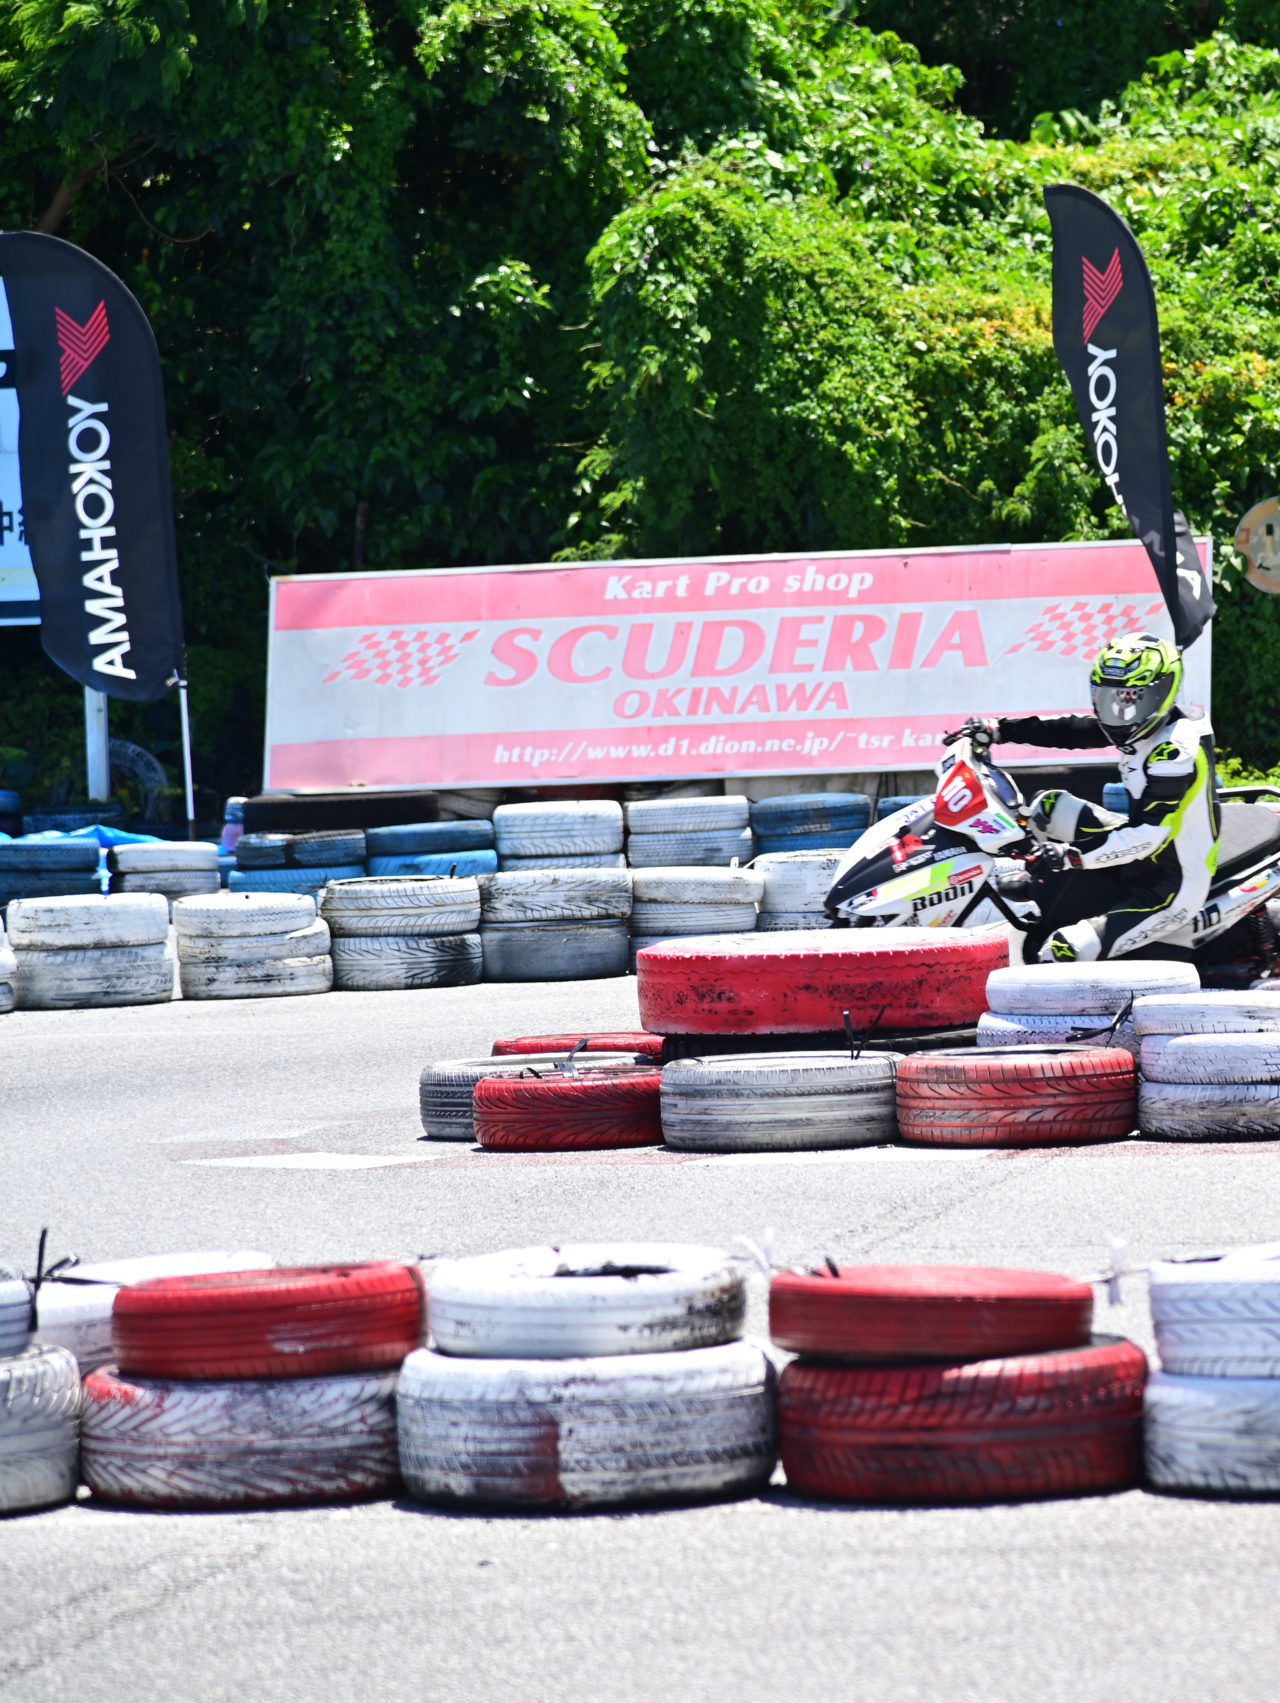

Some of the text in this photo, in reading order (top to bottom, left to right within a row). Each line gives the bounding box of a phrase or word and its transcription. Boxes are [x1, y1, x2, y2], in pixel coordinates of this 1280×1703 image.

[604, 565, 874, 600] Kart Pro shop
[483, 608, 990, 687] SCUDERIA
[612, 681, 850, 719] OKINAWA
